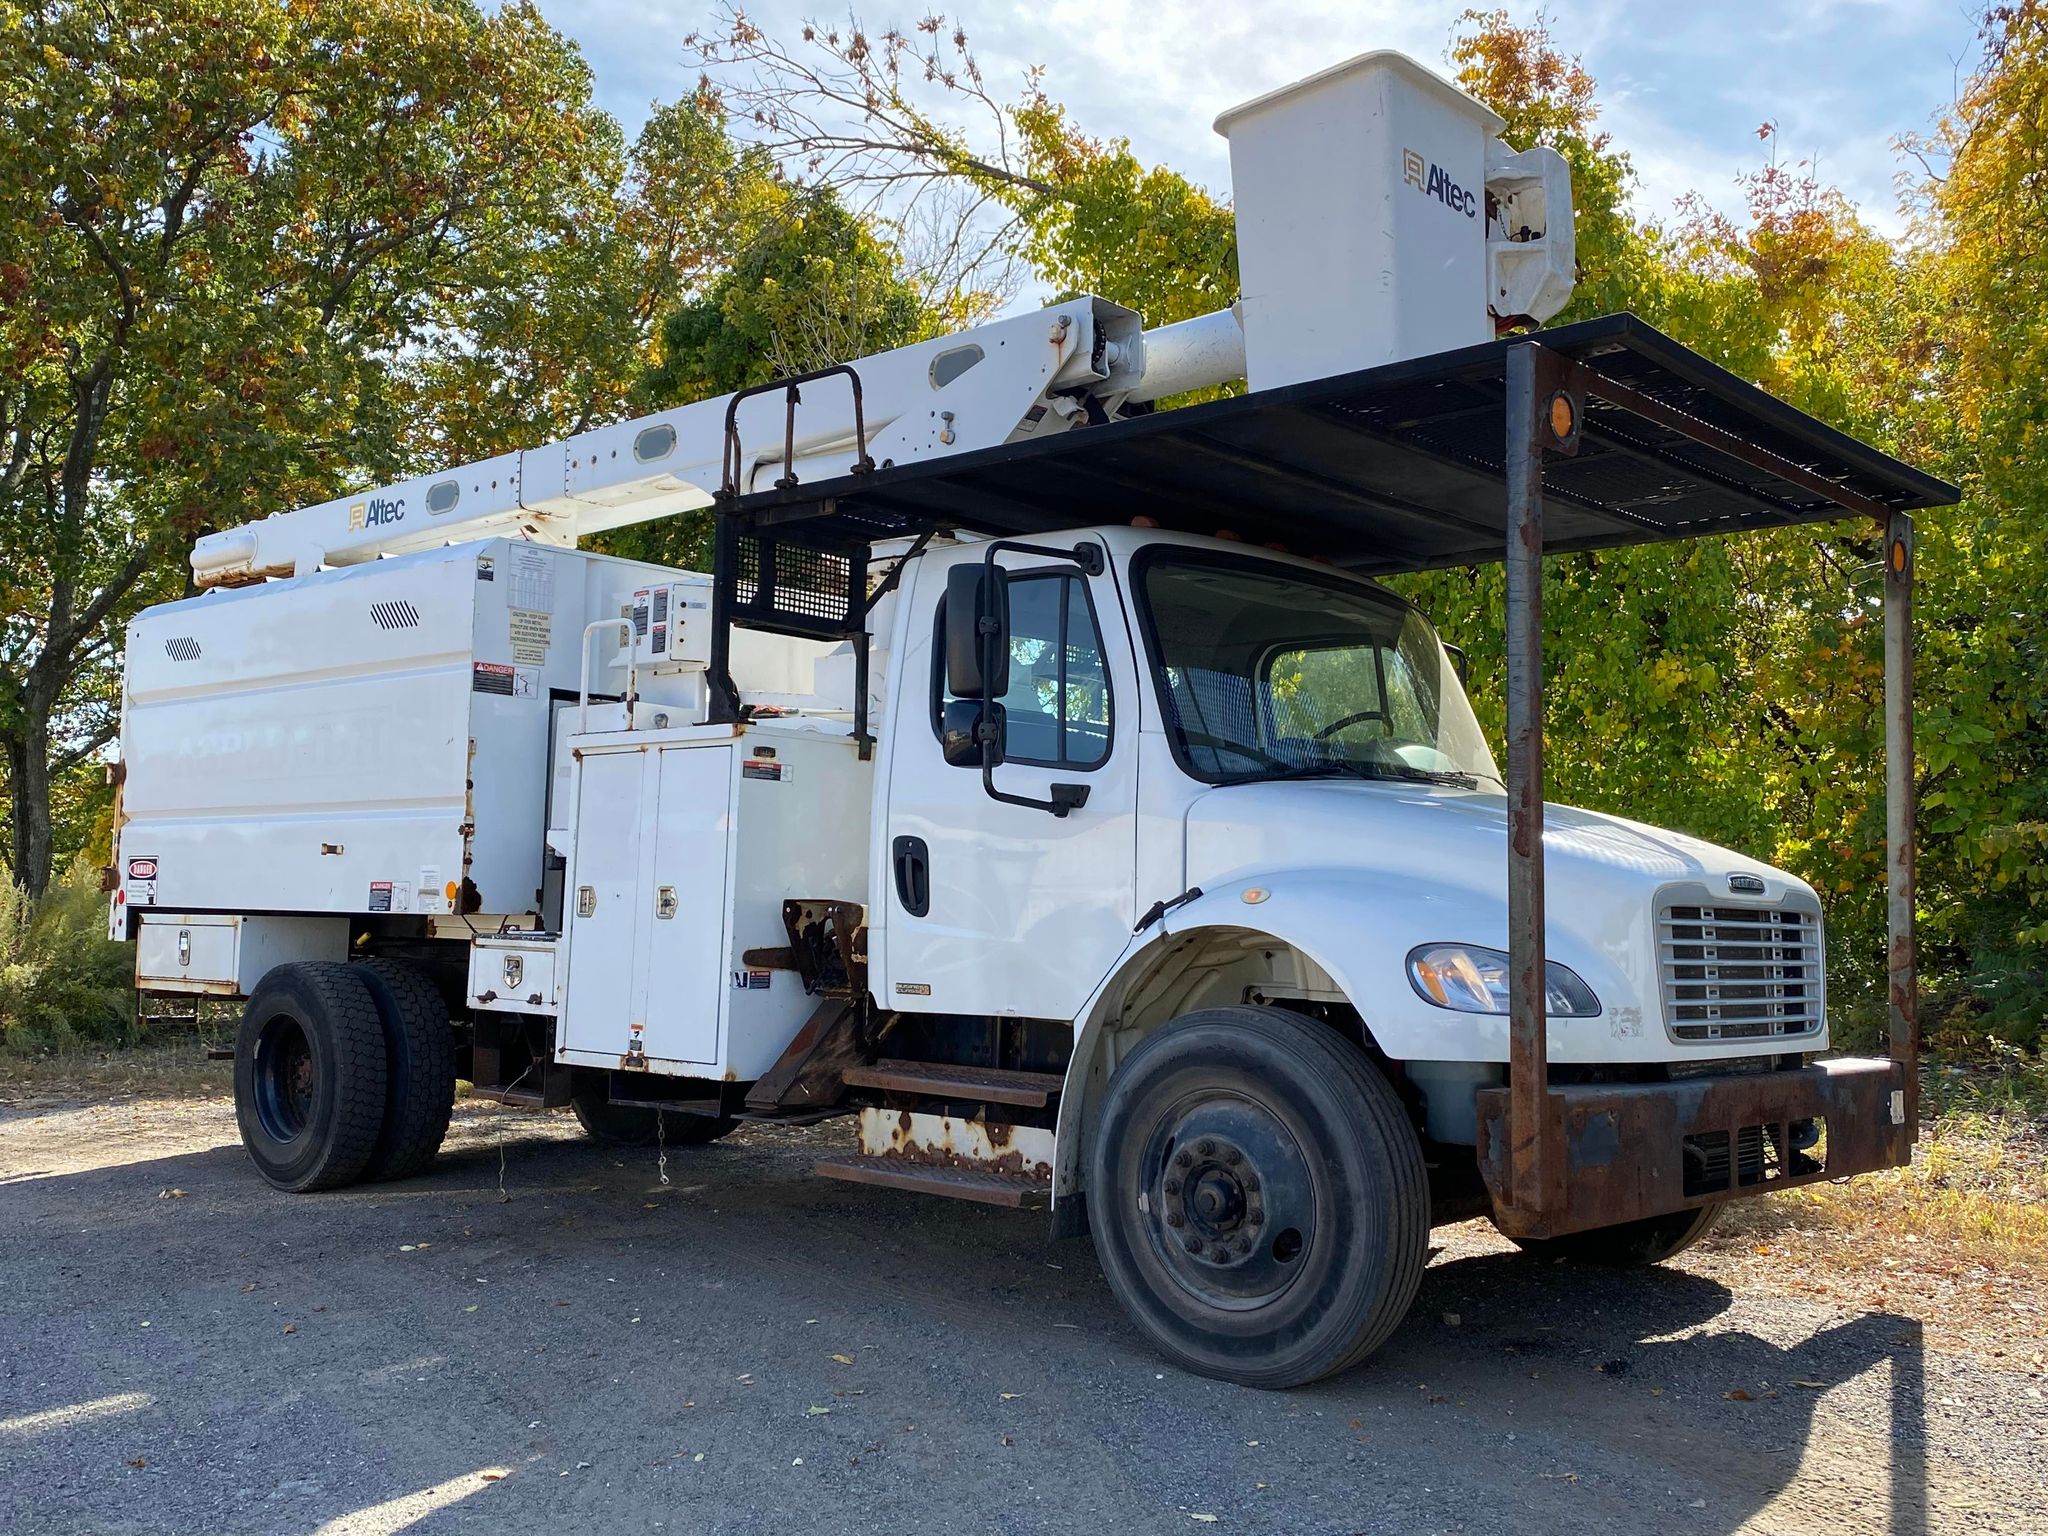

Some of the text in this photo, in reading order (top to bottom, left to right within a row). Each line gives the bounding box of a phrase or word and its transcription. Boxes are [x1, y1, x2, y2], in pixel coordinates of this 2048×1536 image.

[1426, 163, 1476, 218] Altec
[365, 498, 405, 528] Altec
[483, 664, 514, 676] DANGER
